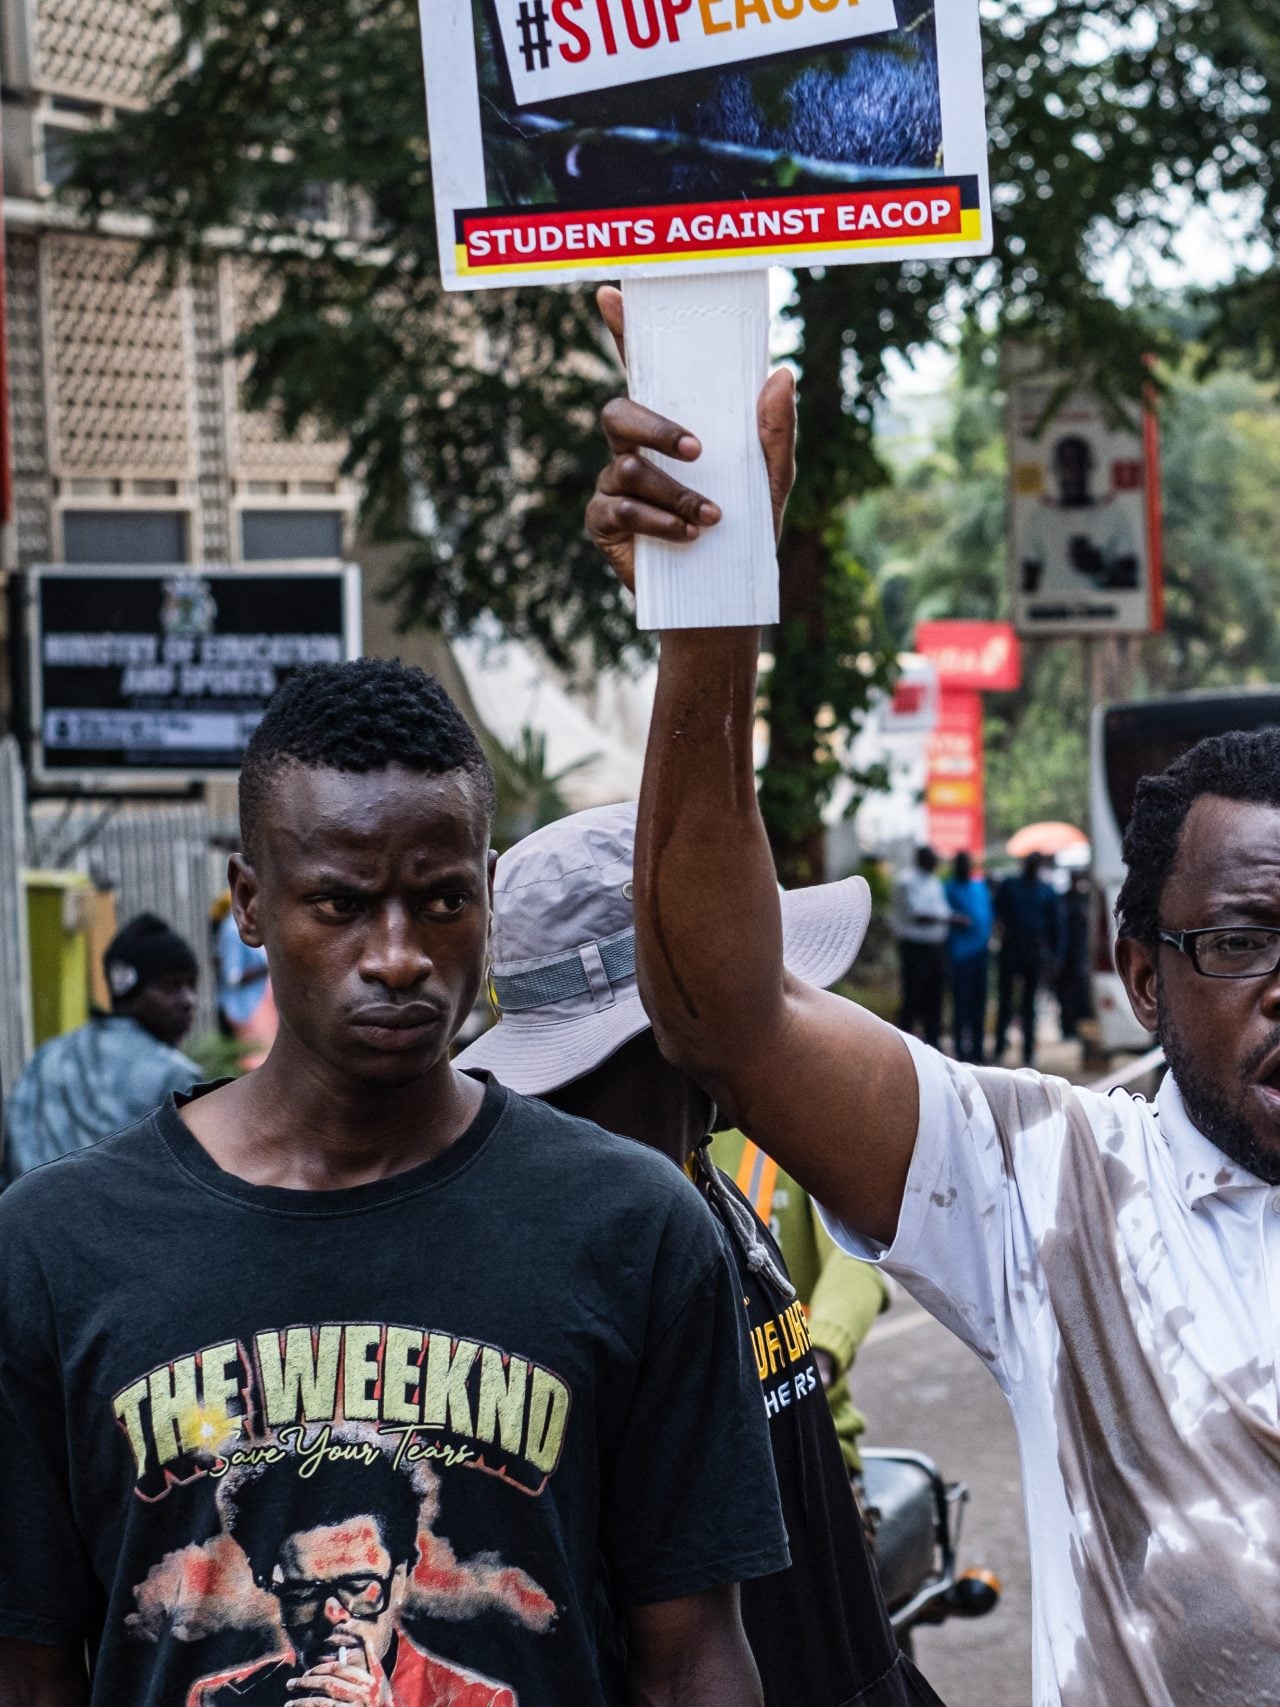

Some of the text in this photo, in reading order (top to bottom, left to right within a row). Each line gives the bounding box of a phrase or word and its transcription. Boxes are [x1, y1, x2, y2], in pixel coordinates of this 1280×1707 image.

[468, 200, 952, 257] STUDENTS AGAINST EACOP
[114, 1324, 570, 1480] THE WEEKND
[208, 1424, 476, 1478] Save Your Tears
